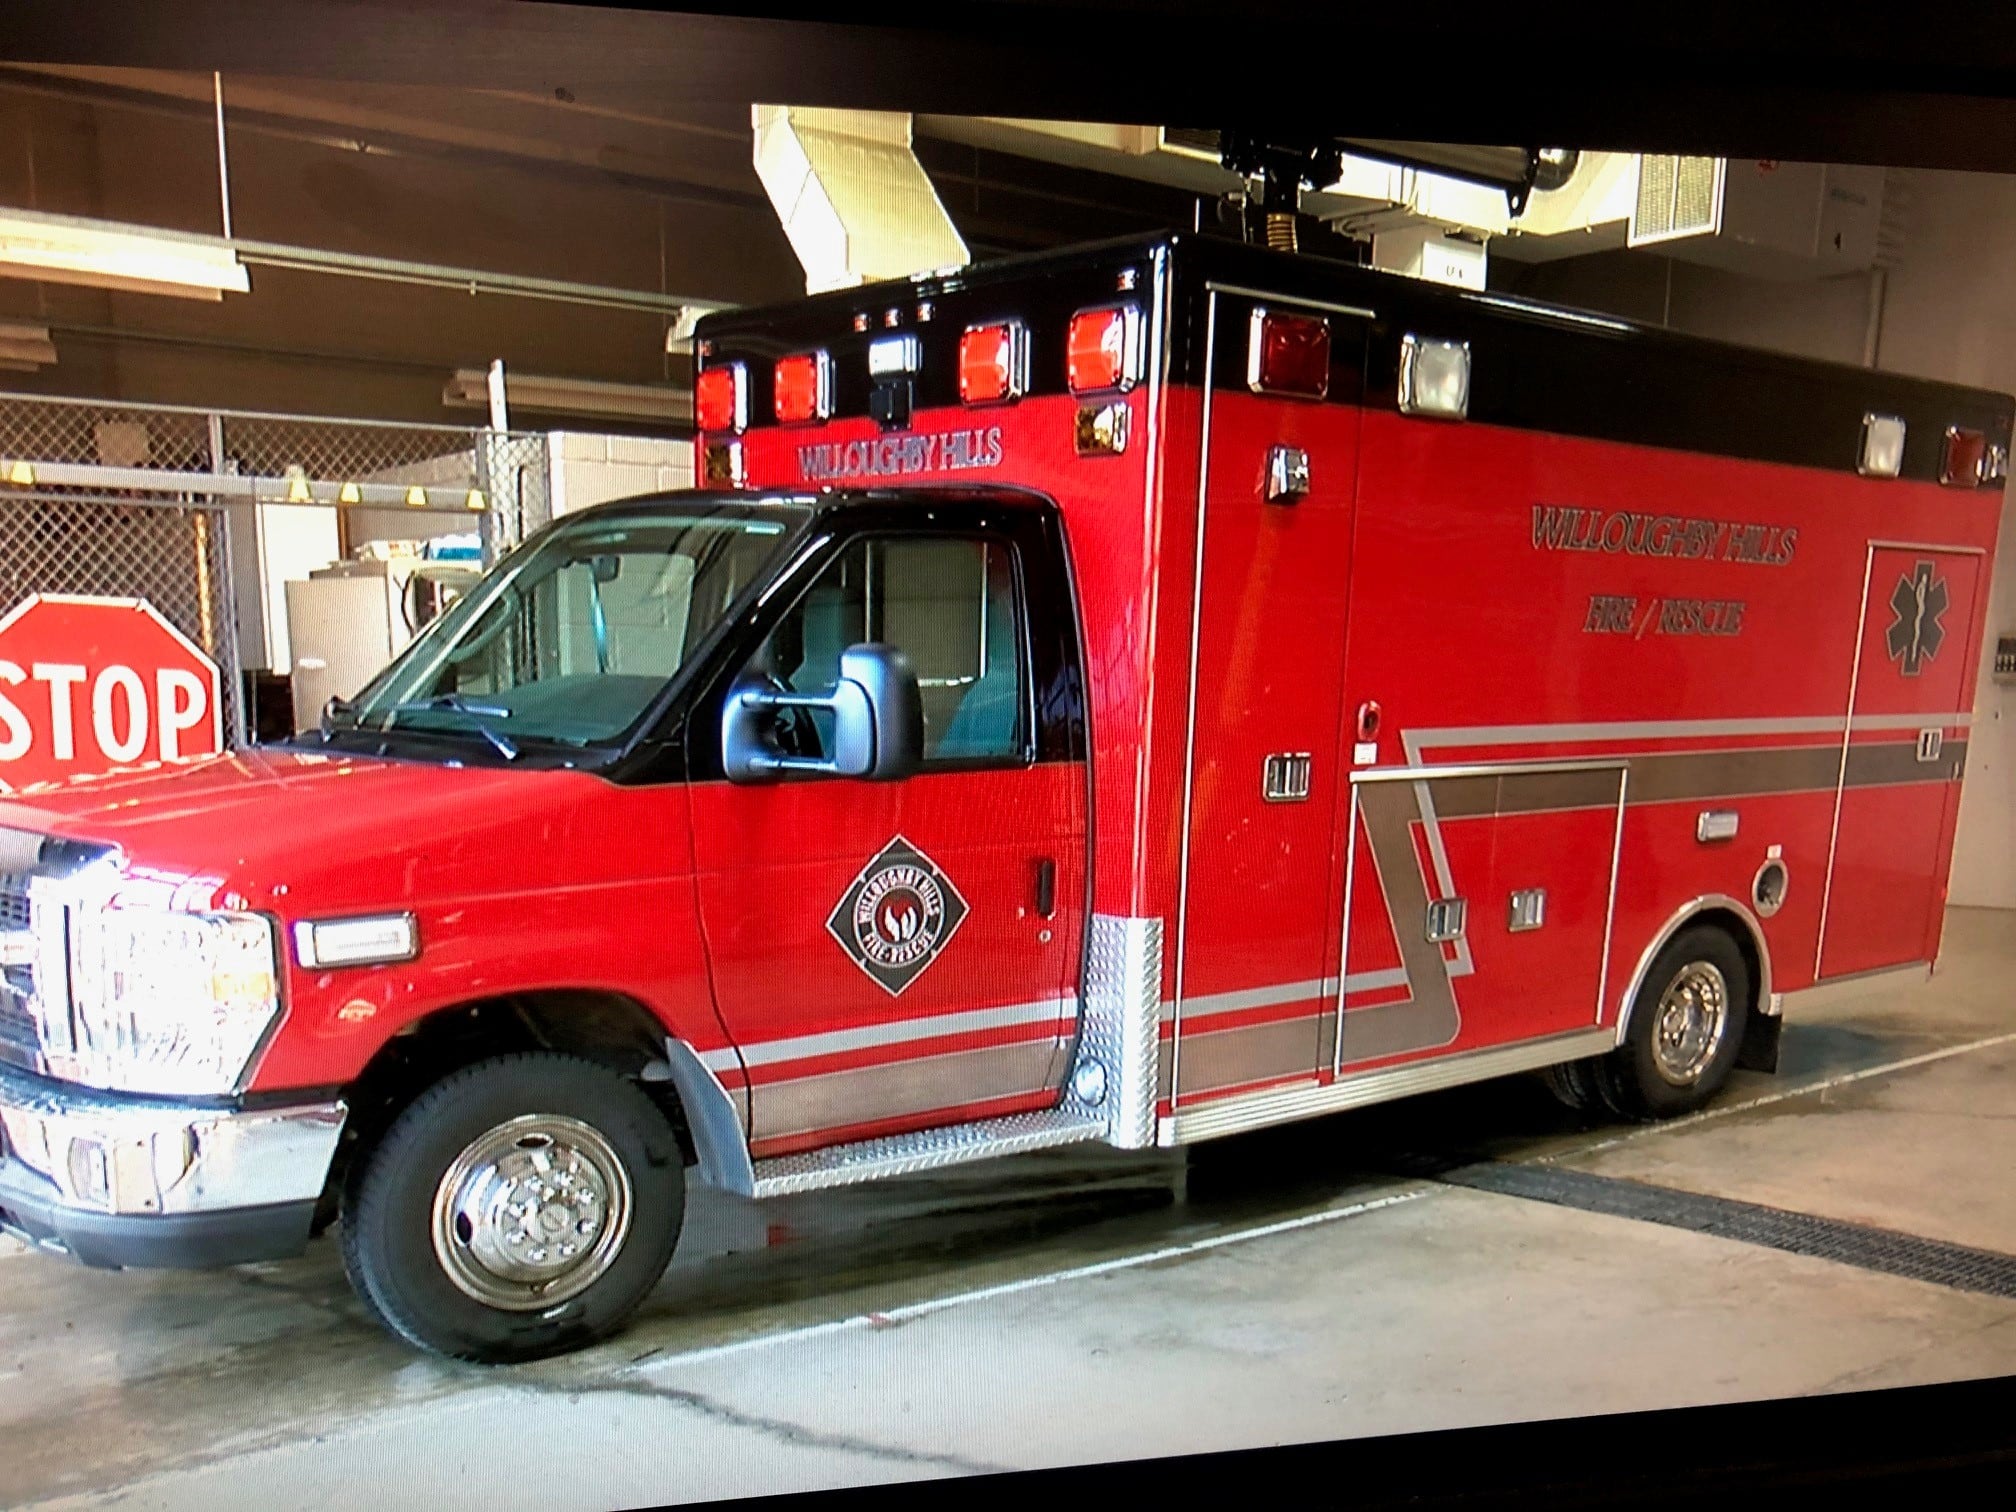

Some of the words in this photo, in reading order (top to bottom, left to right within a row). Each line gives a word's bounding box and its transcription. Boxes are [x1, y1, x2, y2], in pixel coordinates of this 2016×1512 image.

[798, 433, 937, 481] WILLOUGHBY
[939, 427, 1003, 470] HILLS
[1532, 504, 1728, 560] WILLOUGHBY
[1723, 522, 1798, 567] HILLS
[0, 660, 207, 763] STOP
